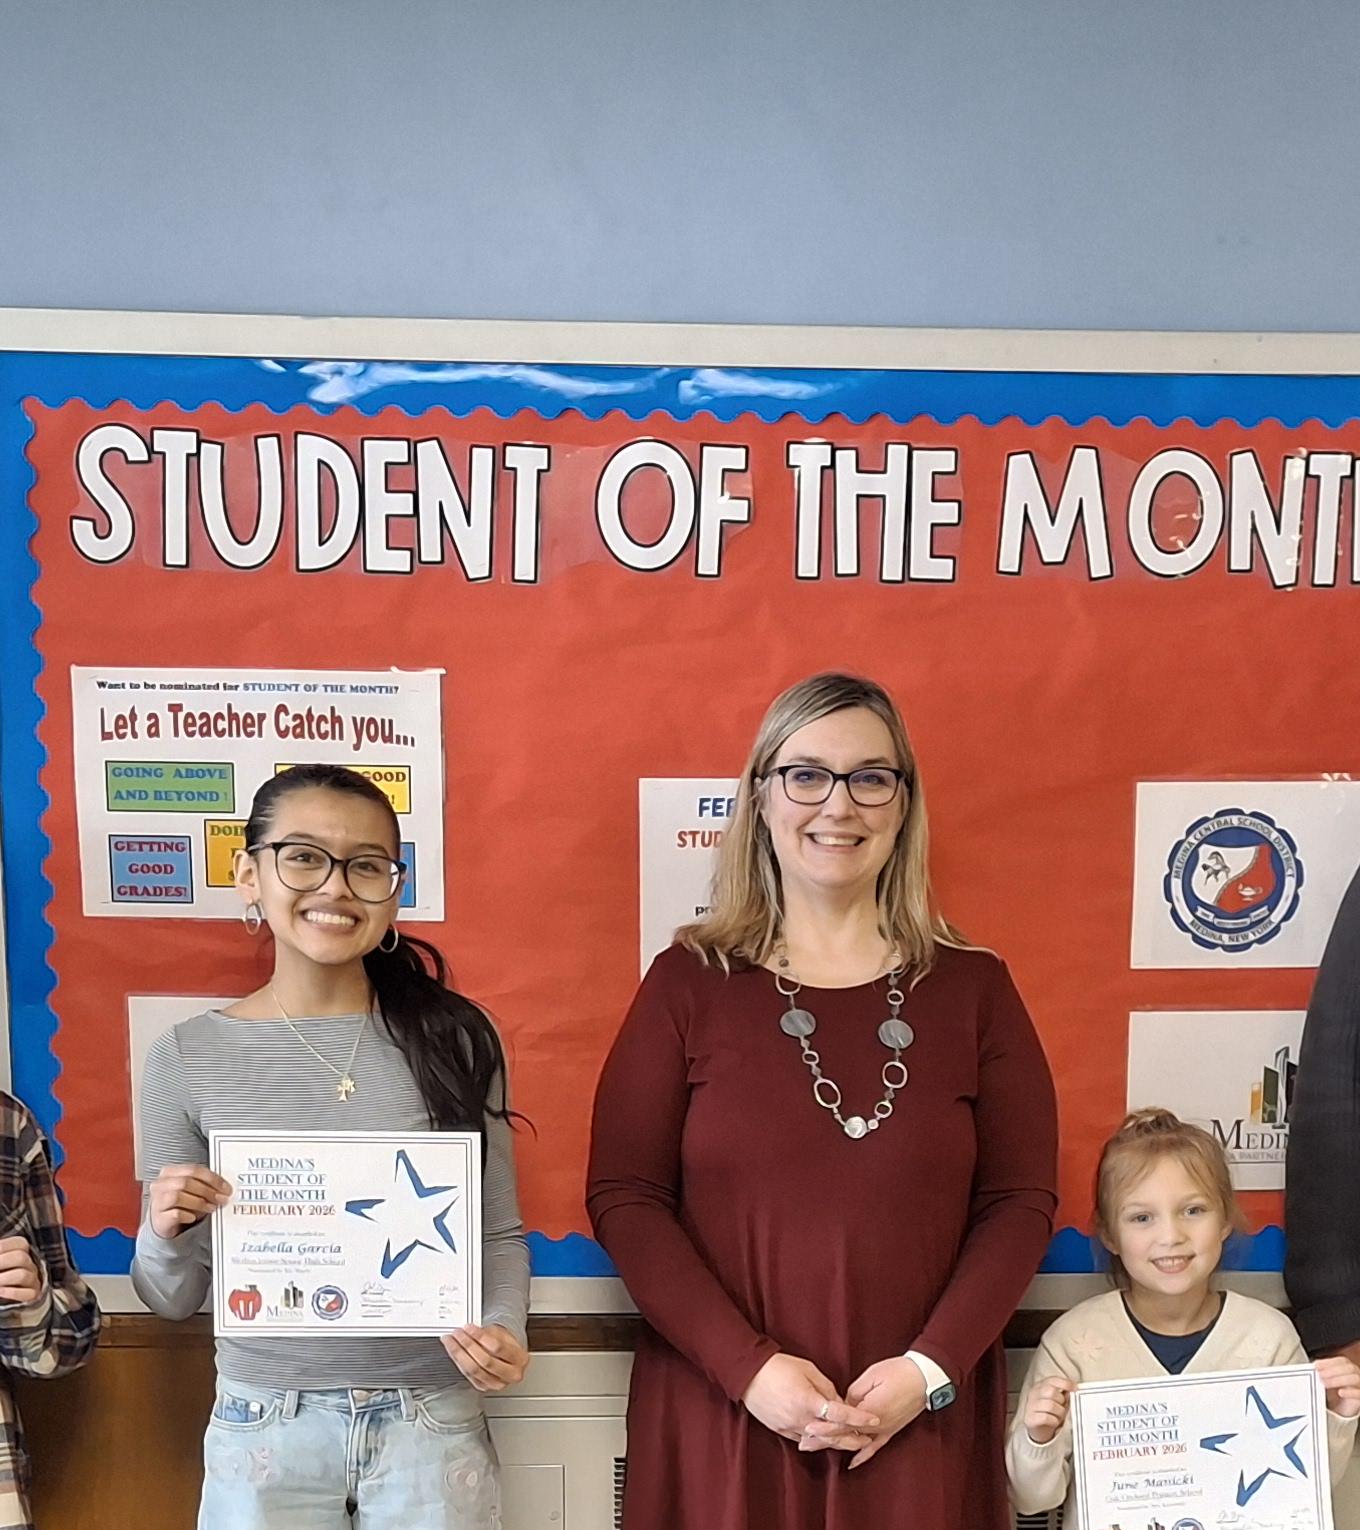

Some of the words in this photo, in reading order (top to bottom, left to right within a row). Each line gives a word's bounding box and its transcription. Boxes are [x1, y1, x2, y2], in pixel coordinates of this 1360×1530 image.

[71, 423, 550, 583] STUDENT
[596, 436, 751, 577] OF
[787, 441, 961, 583] THE
[97, 681, 126, 690] Want
[129, 682, 140, 690] to
[143, 682, 156, 691] be
[159, 682, 220, 691] nominated
[243, 683, 300, 692] STUDENT
[304, 684, 319, 693] OF
[322, 684, 346, 693] THE
[349, 685, 399, 694] MONTH?
[100, 705, 138, 741] Let
[146, 713, 160, 738] a
[167, 703, 267, 740] Teacher
[274, 703, 344, 741] Catch
[352, 713, 416, 751] you...
[112, 767, 164, 778] GOING
[173, 768, 228, 779] ABOVE
[114, 790, 148, 801] AND
[114, 841, 187, 852] GETTING
[1193, 817, 1234, 841] CENTRAL
[1237, 817, 1274, 838] SCHOOL
[1273, 837, 1295, 878] DISTRICT
[128, 864, 175, 874] GOOD
[117, 885, 188, 897] GRADES!
[1228, 933, 1249, 943] NEW
[247, 1158, 315, 1169] MEDINA'S
[237, 1173, 303, 1184] STUDENT
[307, 1173, 327, 1184] OF
[239, 1188, 269, 1200] THE
[272, 1189, 326, 1200] MONTH
[233, 1204, 305, 1215] FEBRUARY
[1106, 1402, 1168, 1416] MEDINA'S
[1097, 1417, 1159, 1431] STUDENT
[1161, 1415, 1179, 1427] OF
[1100, 1435, 1126, 1446] THE
[1129, 1429, 1179, 1443] MONTH
[1093, 1445, 1158, 1460] FEBRUARY
[1162, 1442, 1187, 1455] 2026
